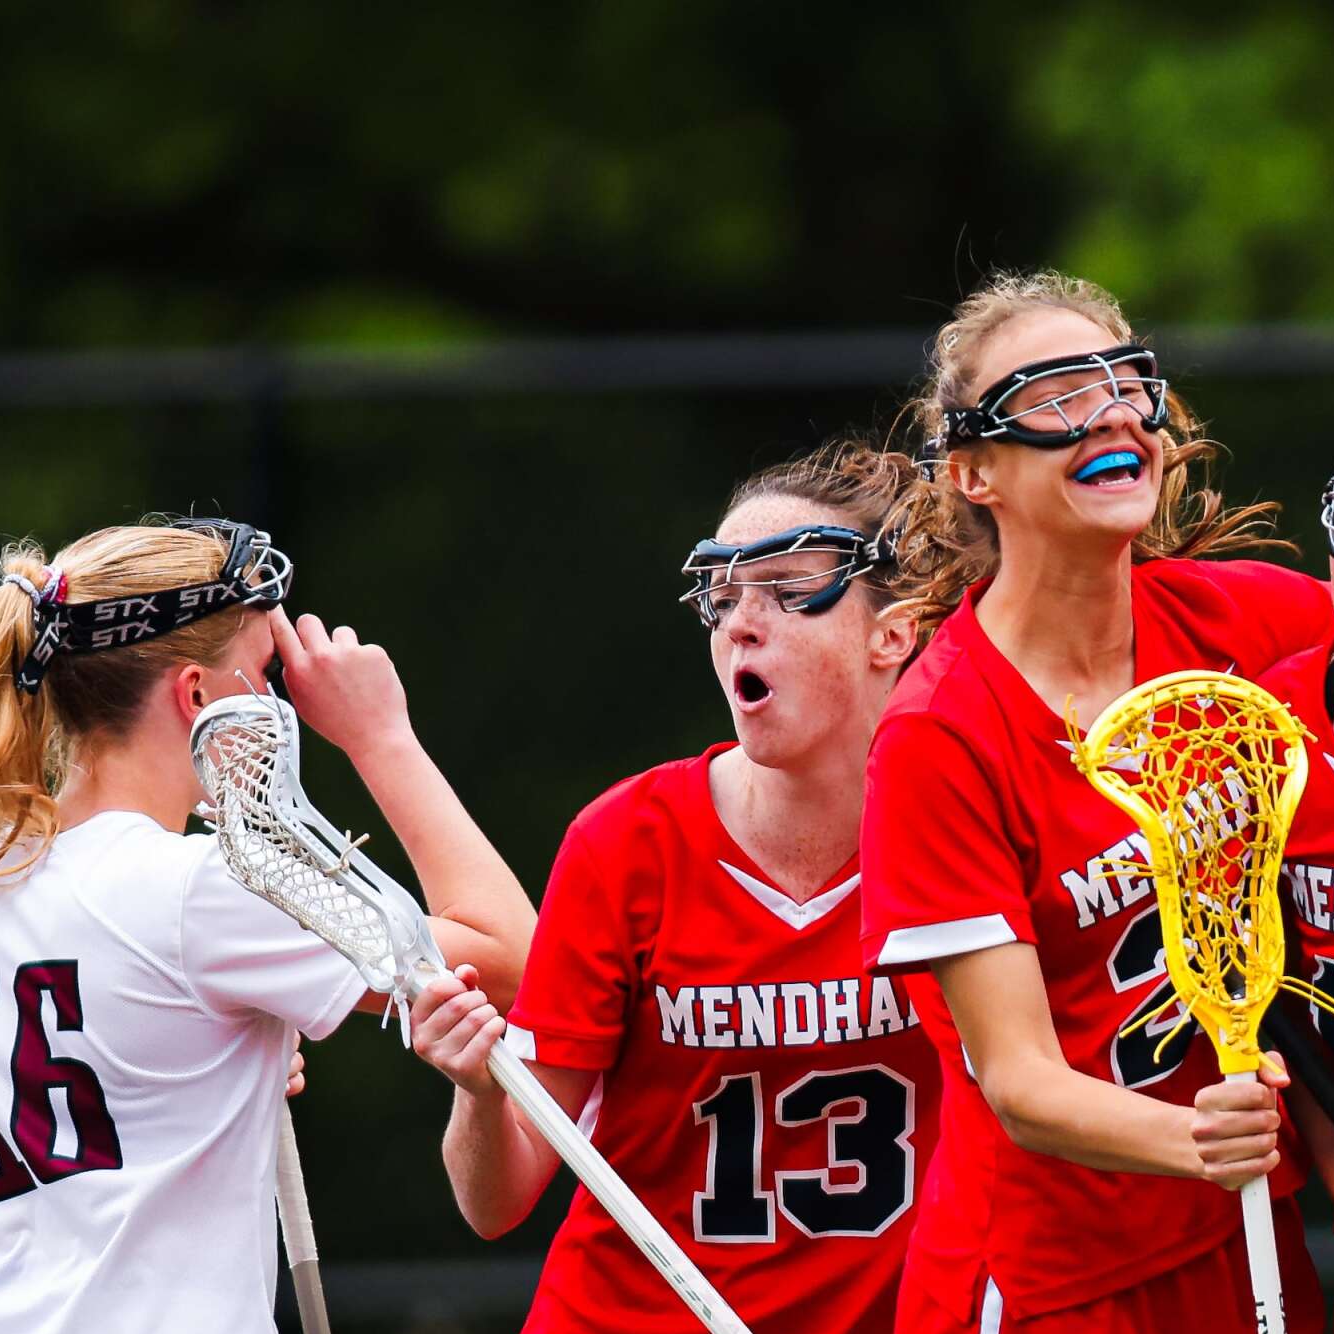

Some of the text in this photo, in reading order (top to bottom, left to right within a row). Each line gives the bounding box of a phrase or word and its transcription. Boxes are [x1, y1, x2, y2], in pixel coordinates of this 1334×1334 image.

[94, 595, 160, 621] STX
[179, 582, 240, 608] STX
[92, 619, 156, 648] STX
[655, 976, 921, 1048] MENDHA
[692, 1062, 916, 1244] 13
